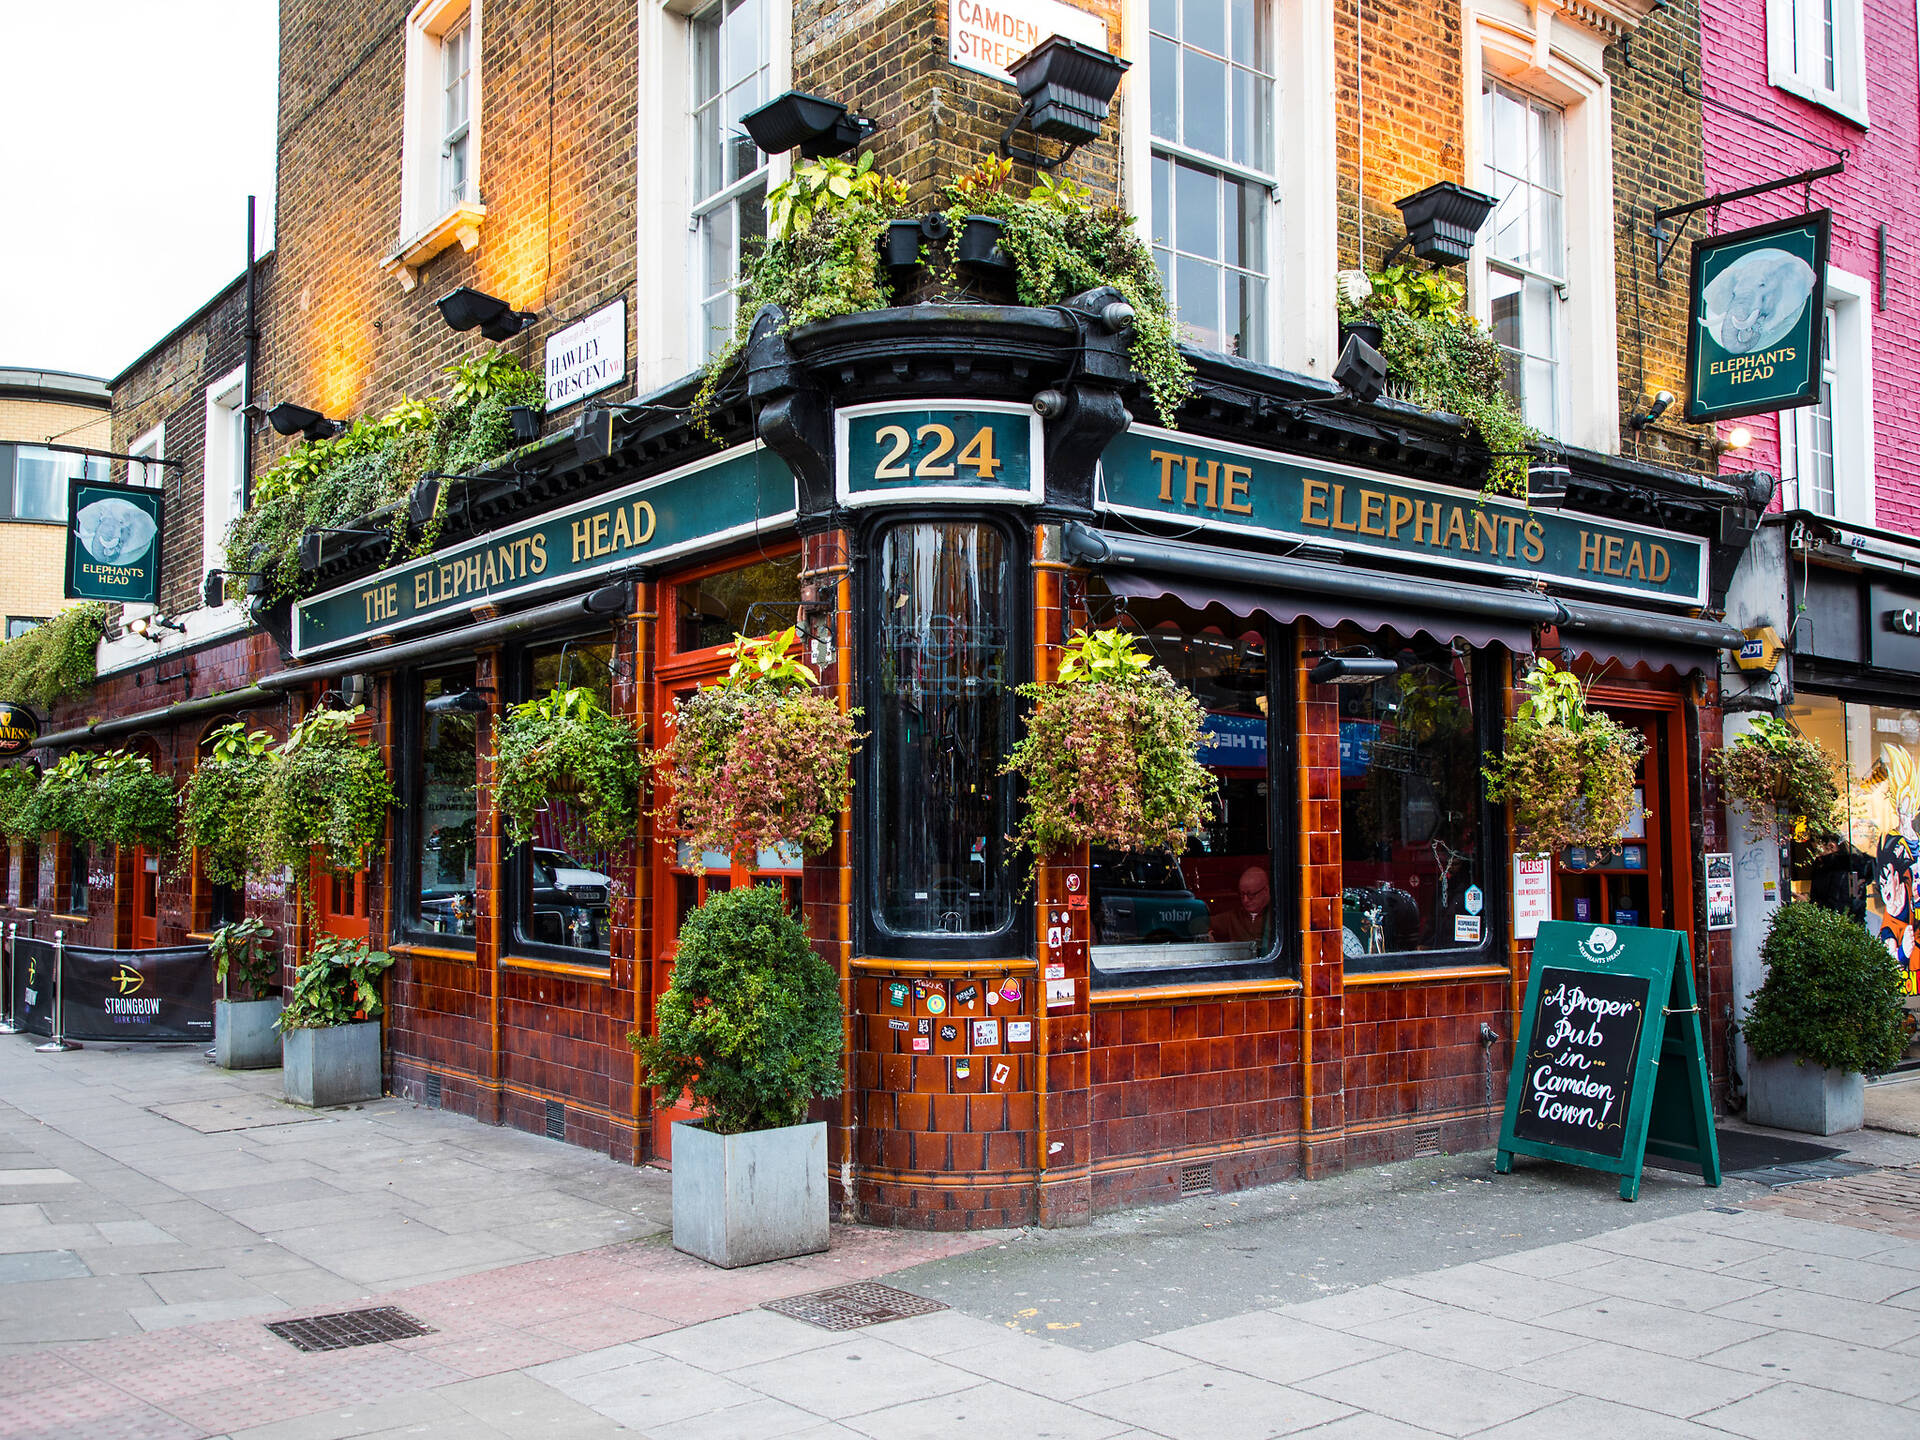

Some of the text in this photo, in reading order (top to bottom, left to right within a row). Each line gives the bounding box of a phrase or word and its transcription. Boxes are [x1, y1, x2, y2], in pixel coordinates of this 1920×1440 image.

[958, 0, 1038, 45] CAMDEN
[958, 30, 1026, 67] STREE
[551, 336, 601, 377] HAWLEY
[1730, 365, 1774, 385] HEAD
[549, 358, 608, 401] CRESCENT
[874, 423, 1002, 481] 224
[1150, 449, 1672, 583] THE ELEPHANTS HEAD
[1851, 534, 1867, 548] 222
[98, 574, 130, 586] HEAD
[362, 500, 657, 625] THE ELEPHANTS HEAD
[1740, 640, 1763, 655] ADT
[1520, 859, 1543, 873] PLEASE
[1605, 949, 1621, 963] HEAD
[104, 997, 160, 1015] STRONGBOW
[1544, 983, 1634, 1023] A Proper
[1546, 1016, 1604, 1049] Pub
[1532, 1064, 1616, 1101] Camden
[1534, 1091, 1613, 1131] Town!
